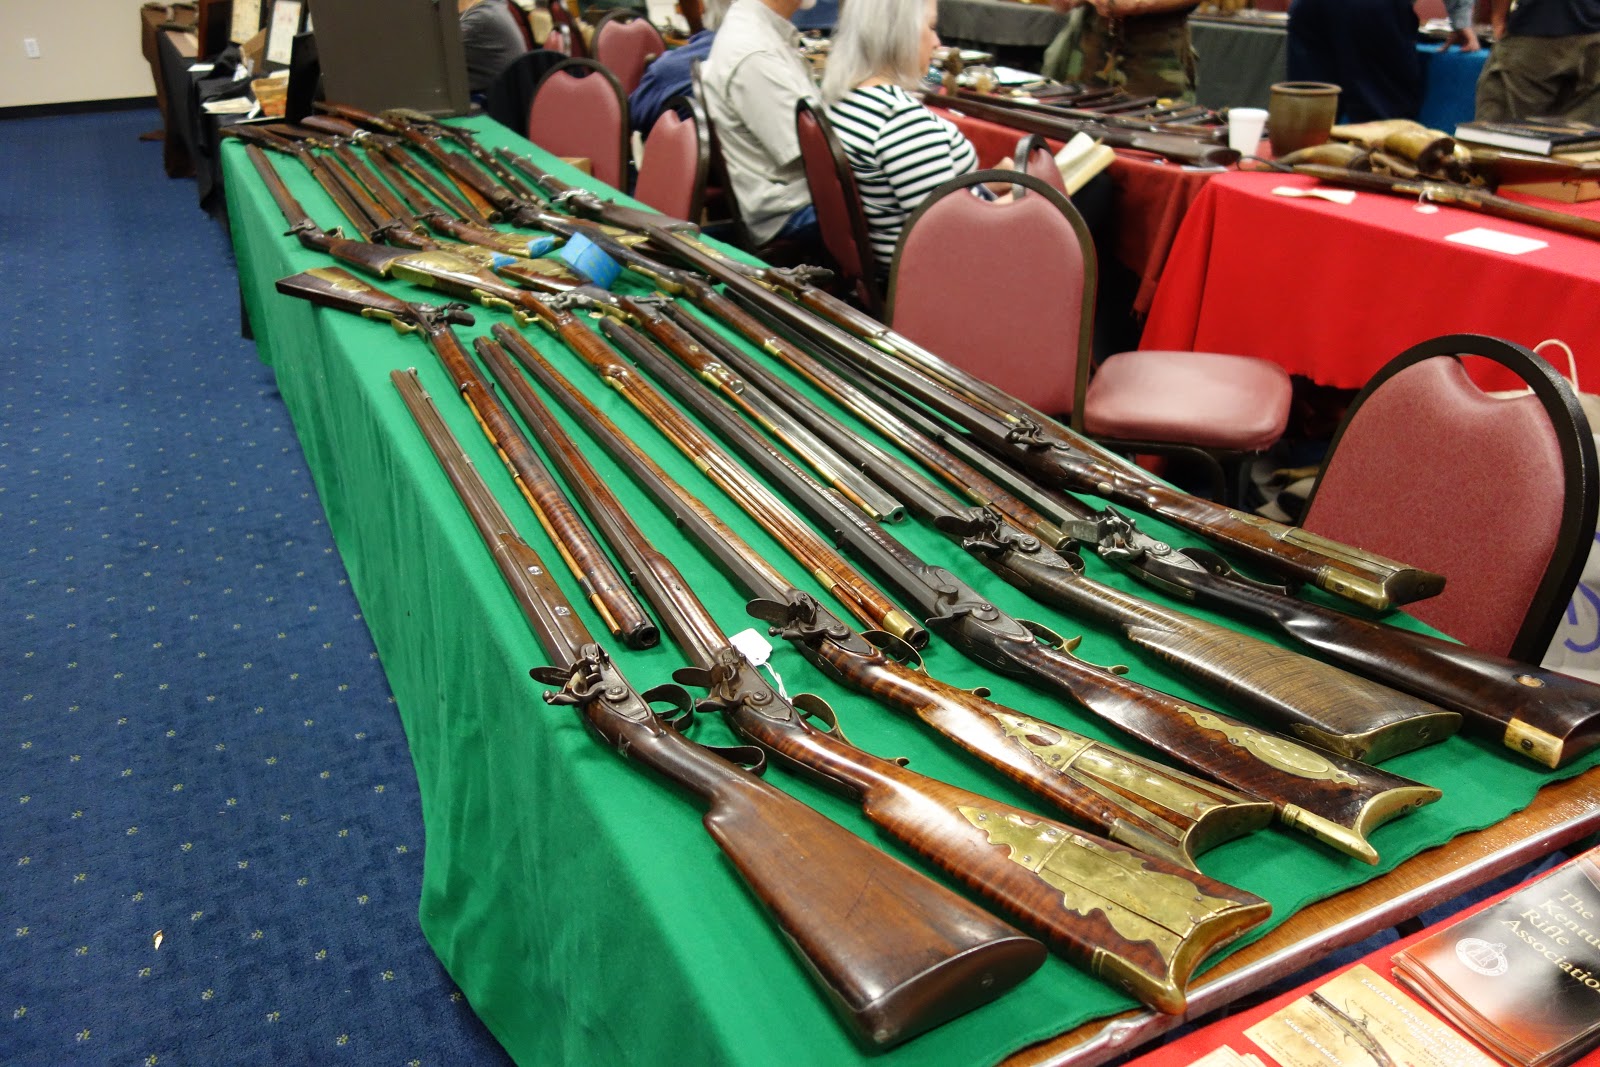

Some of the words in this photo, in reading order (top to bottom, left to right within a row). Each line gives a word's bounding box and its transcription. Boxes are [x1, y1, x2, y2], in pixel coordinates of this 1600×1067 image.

[1539, 899, 1600, 950] Kentu
[1560, 889, 1594, 919] The
[1520, 908, 1570, 945] Rifle
[1500, 919, 1600, 993] Associatio
